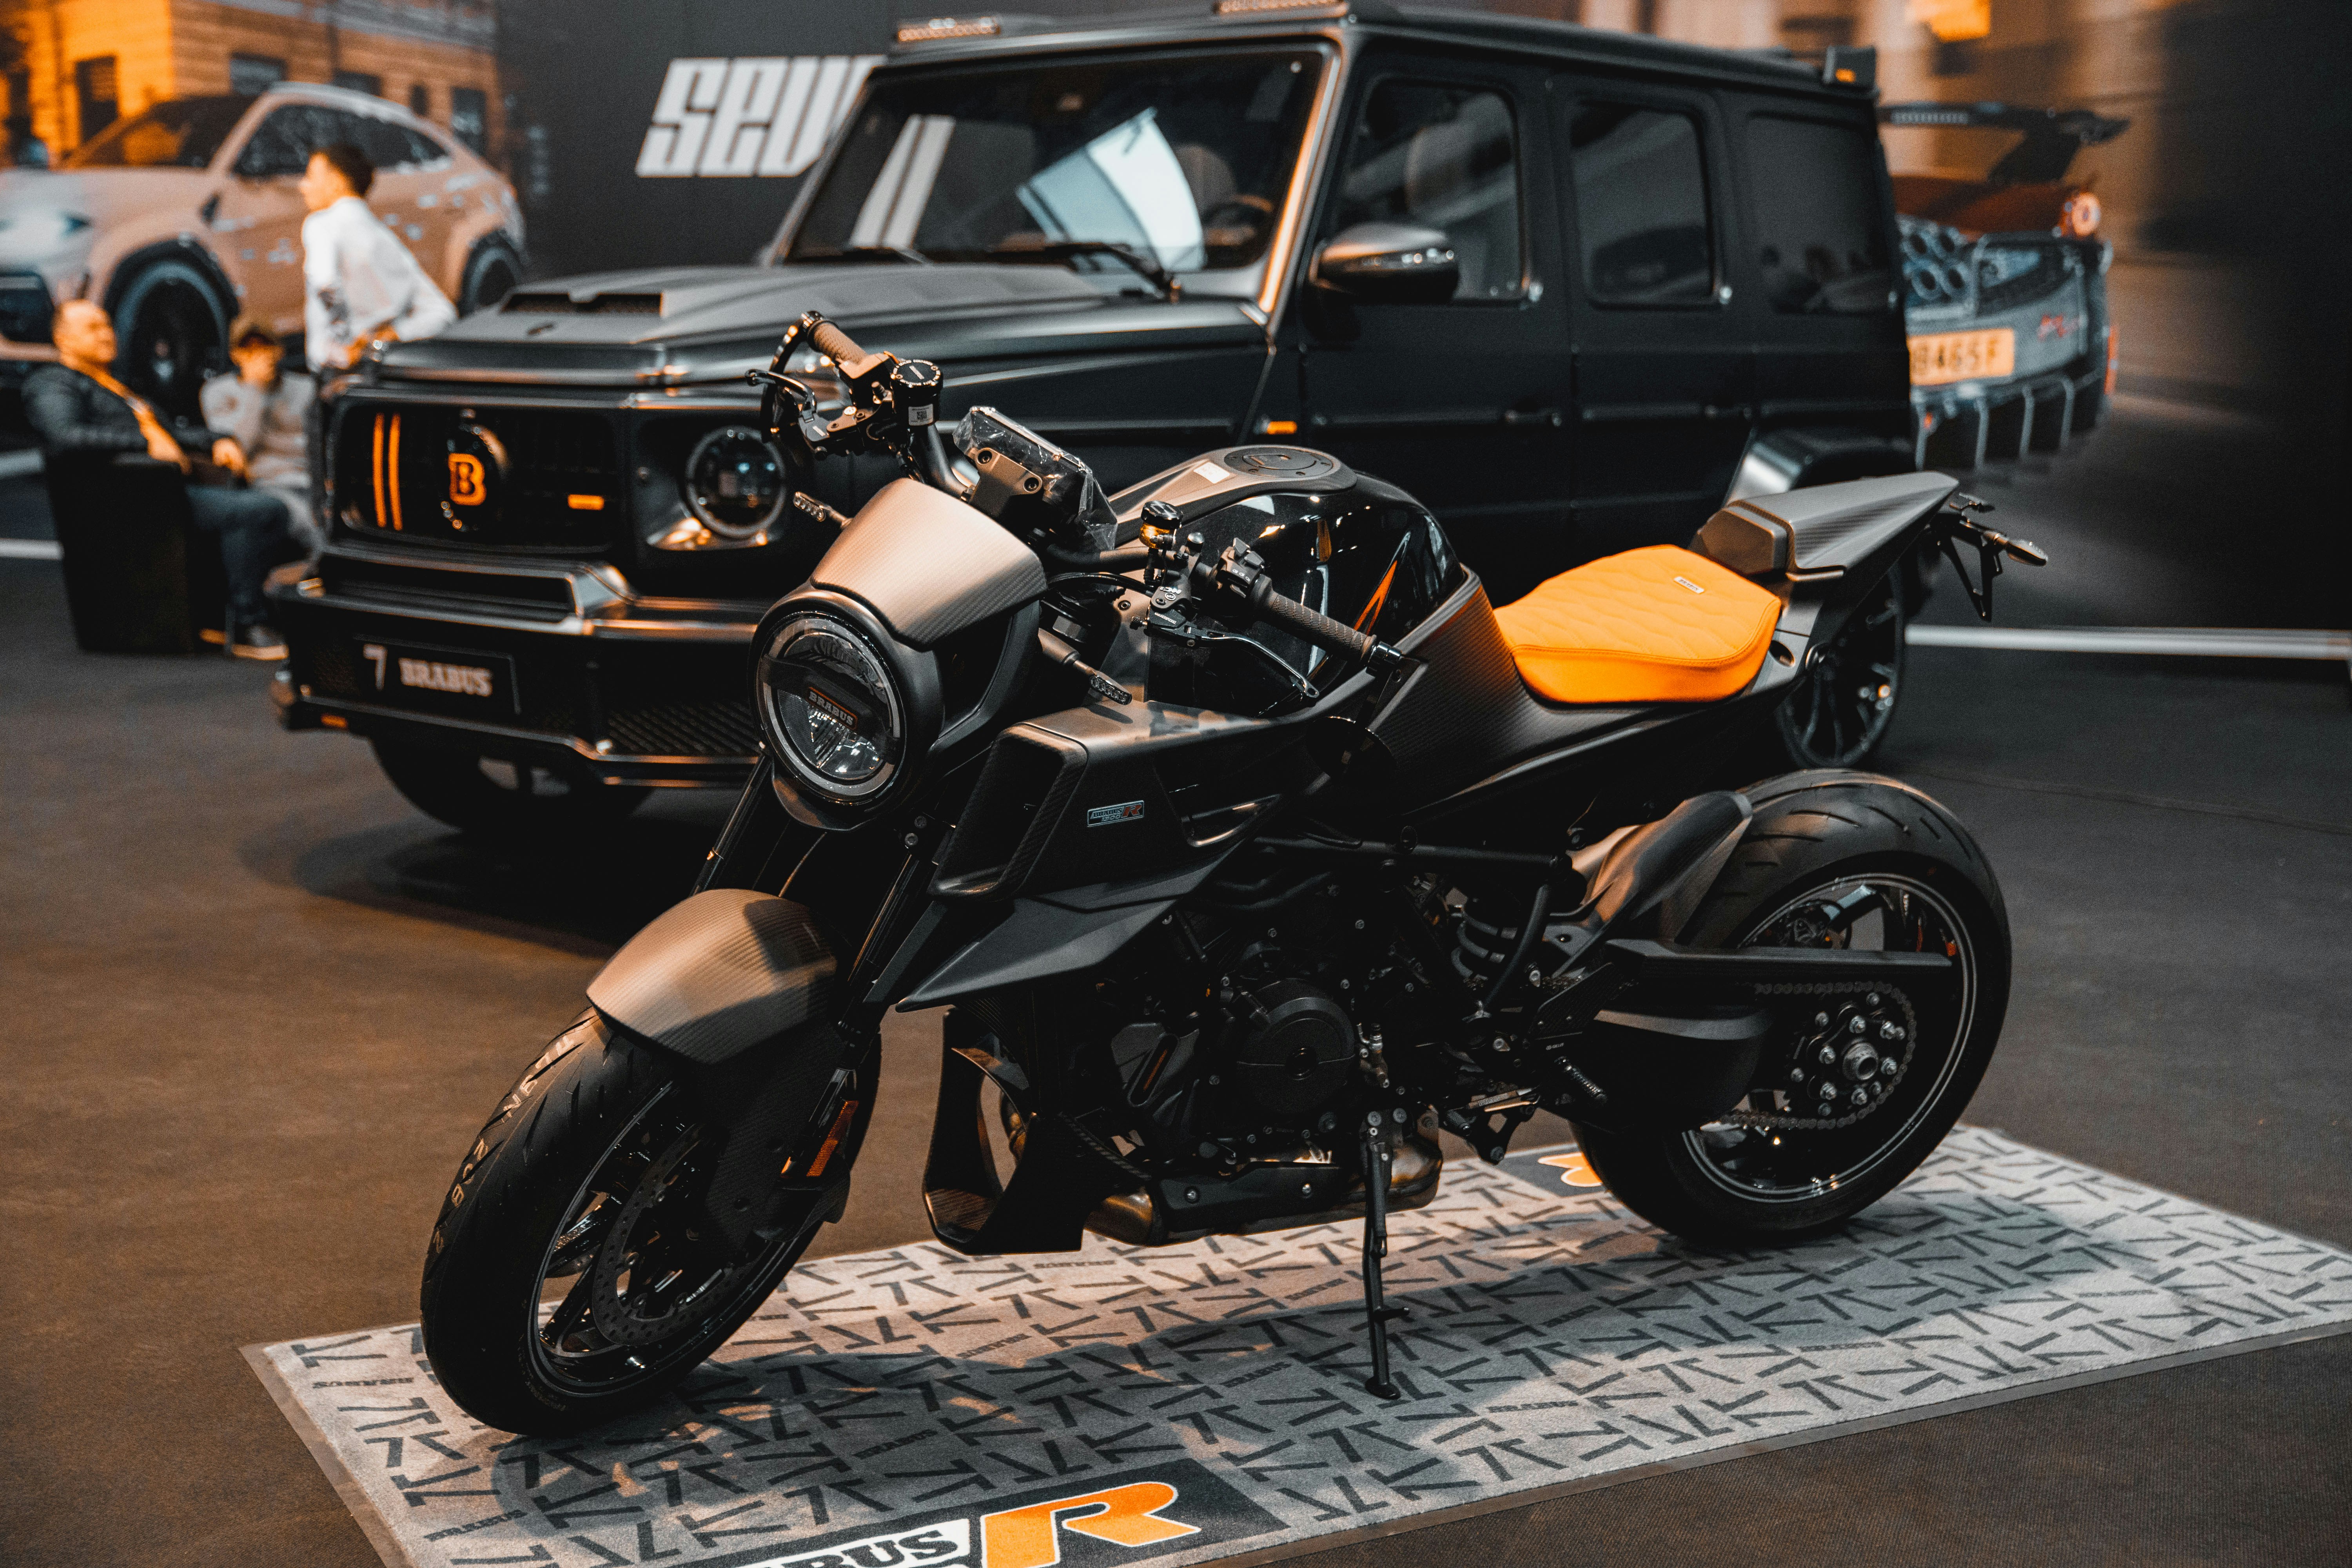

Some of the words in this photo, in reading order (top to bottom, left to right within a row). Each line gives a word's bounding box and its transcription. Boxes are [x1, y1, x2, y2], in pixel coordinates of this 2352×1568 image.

[448, 453, 486, 506] B
[363, 644, 388, 691] 7
[398, 657, 493, 697] BRABUS
[809, 691, 855, 726] BRABUS
[1093, 808, 1122, 817] BRABUS
[1121, 804, 1142, 818] R
[313, 1377, 413, 1389] BRABUS
[424, 1509, 526, 1541] BRABUS
